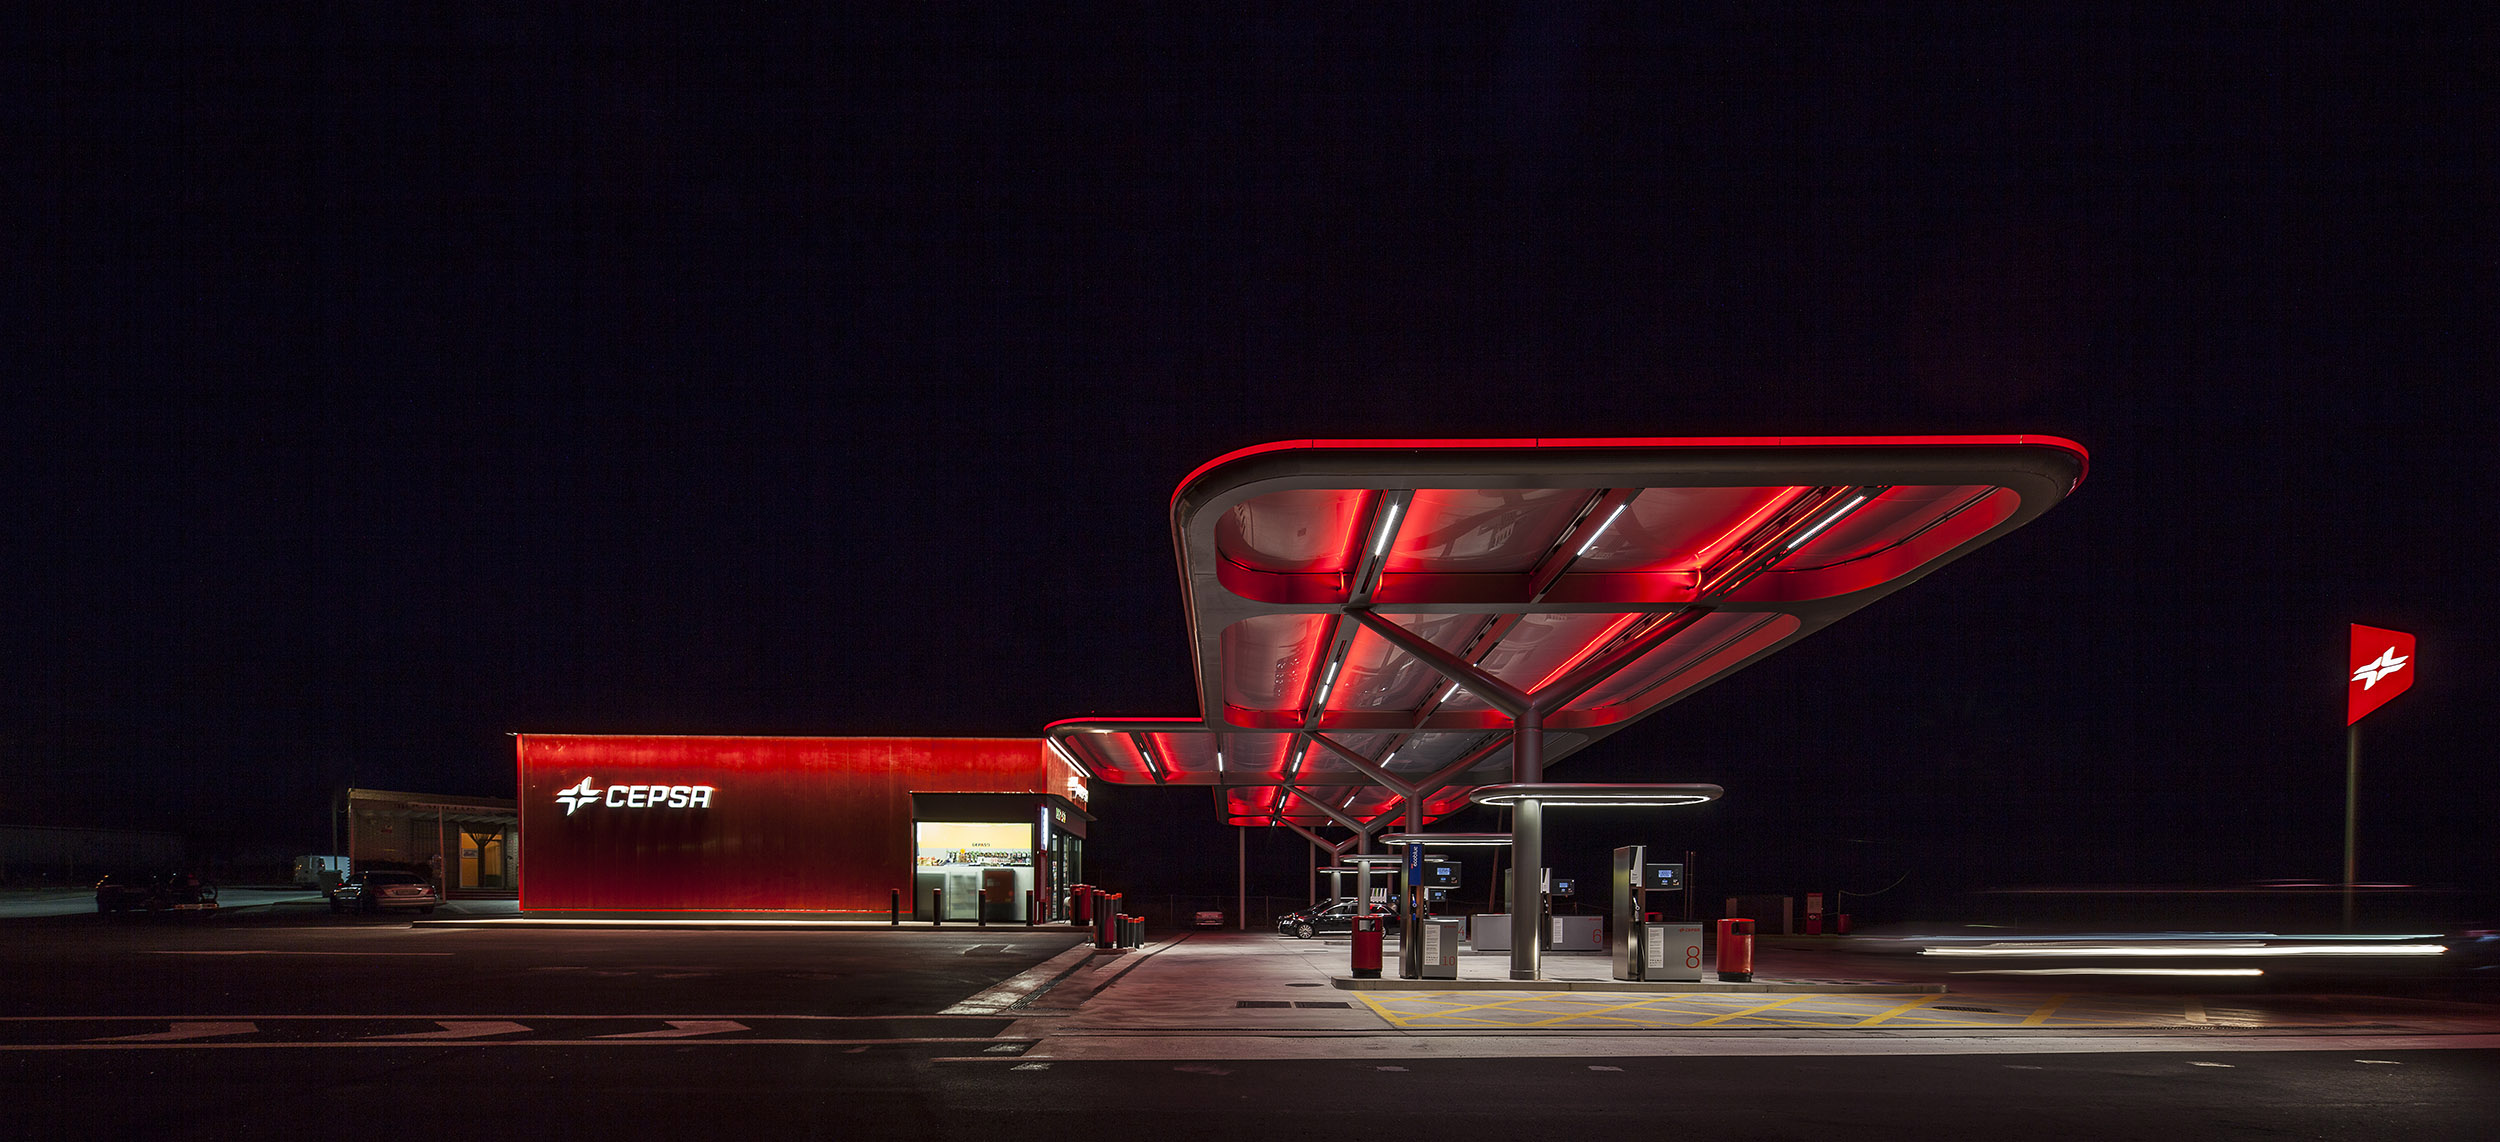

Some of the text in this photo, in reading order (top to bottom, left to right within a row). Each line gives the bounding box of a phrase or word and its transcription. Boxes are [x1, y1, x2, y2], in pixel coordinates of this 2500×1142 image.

[606, 785, 712, 808] CEPSA
[1592, 928, 1602, 944] 6
[1440, 955, 1456, 967] 10
[1686, 945, 1700, 969] 8
